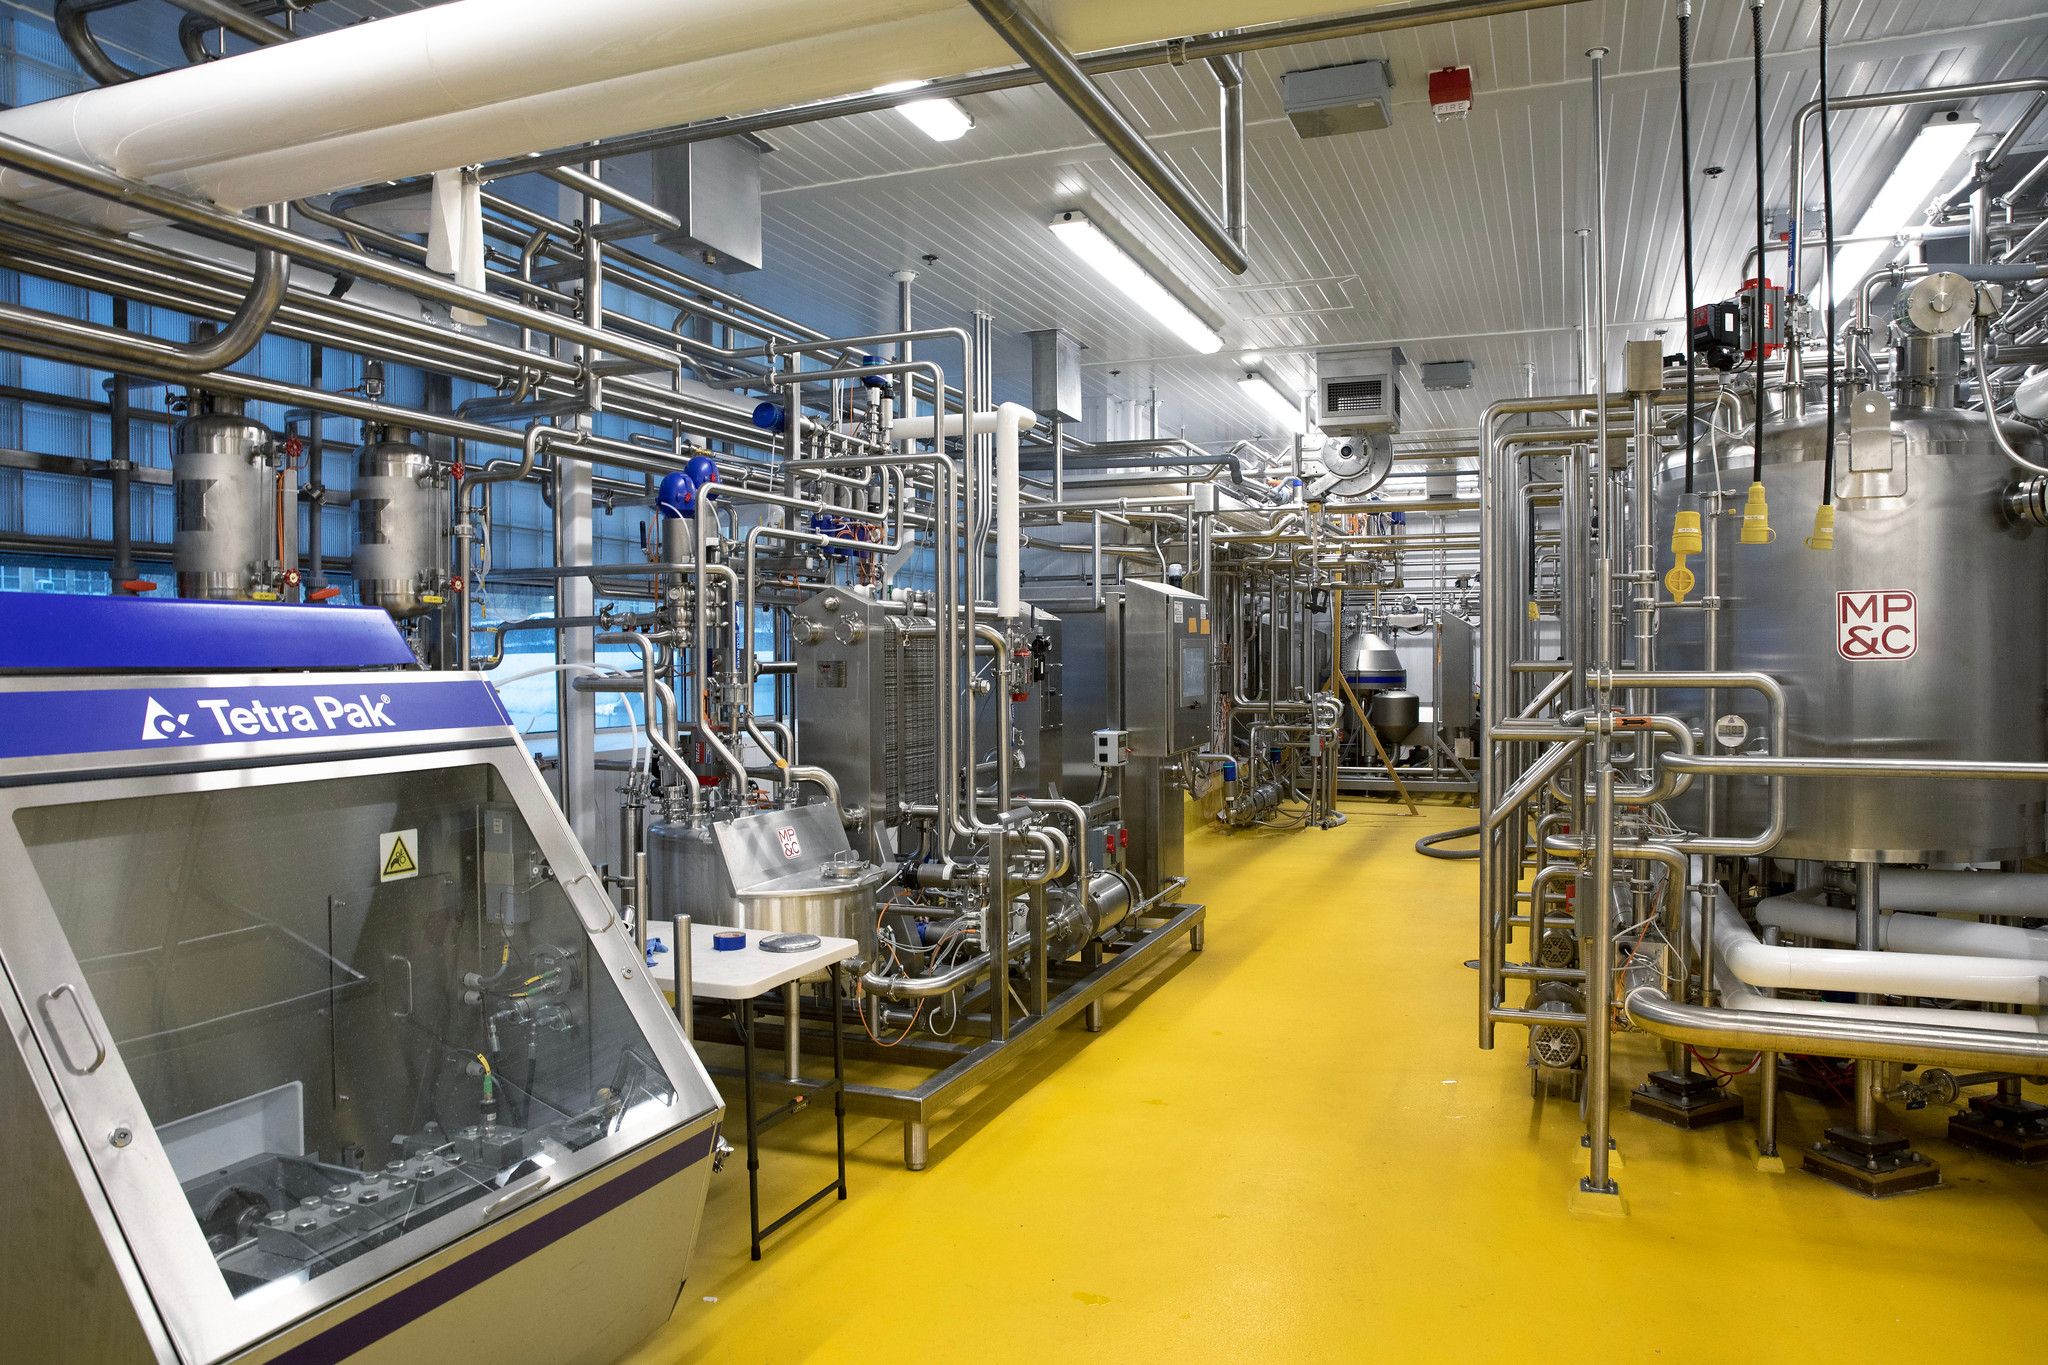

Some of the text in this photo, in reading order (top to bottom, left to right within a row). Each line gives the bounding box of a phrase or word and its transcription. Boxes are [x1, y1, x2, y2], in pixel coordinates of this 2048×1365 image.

[1437, 103, 1464, 112] FIRE
[1842, 594, 1913, 624] MP
[1842, 625, 1911, 656] &C
[197, 699, 319, 736] Tetra
[778, 828, 795, 843] MP
[784, 841, 800, 857] &C
